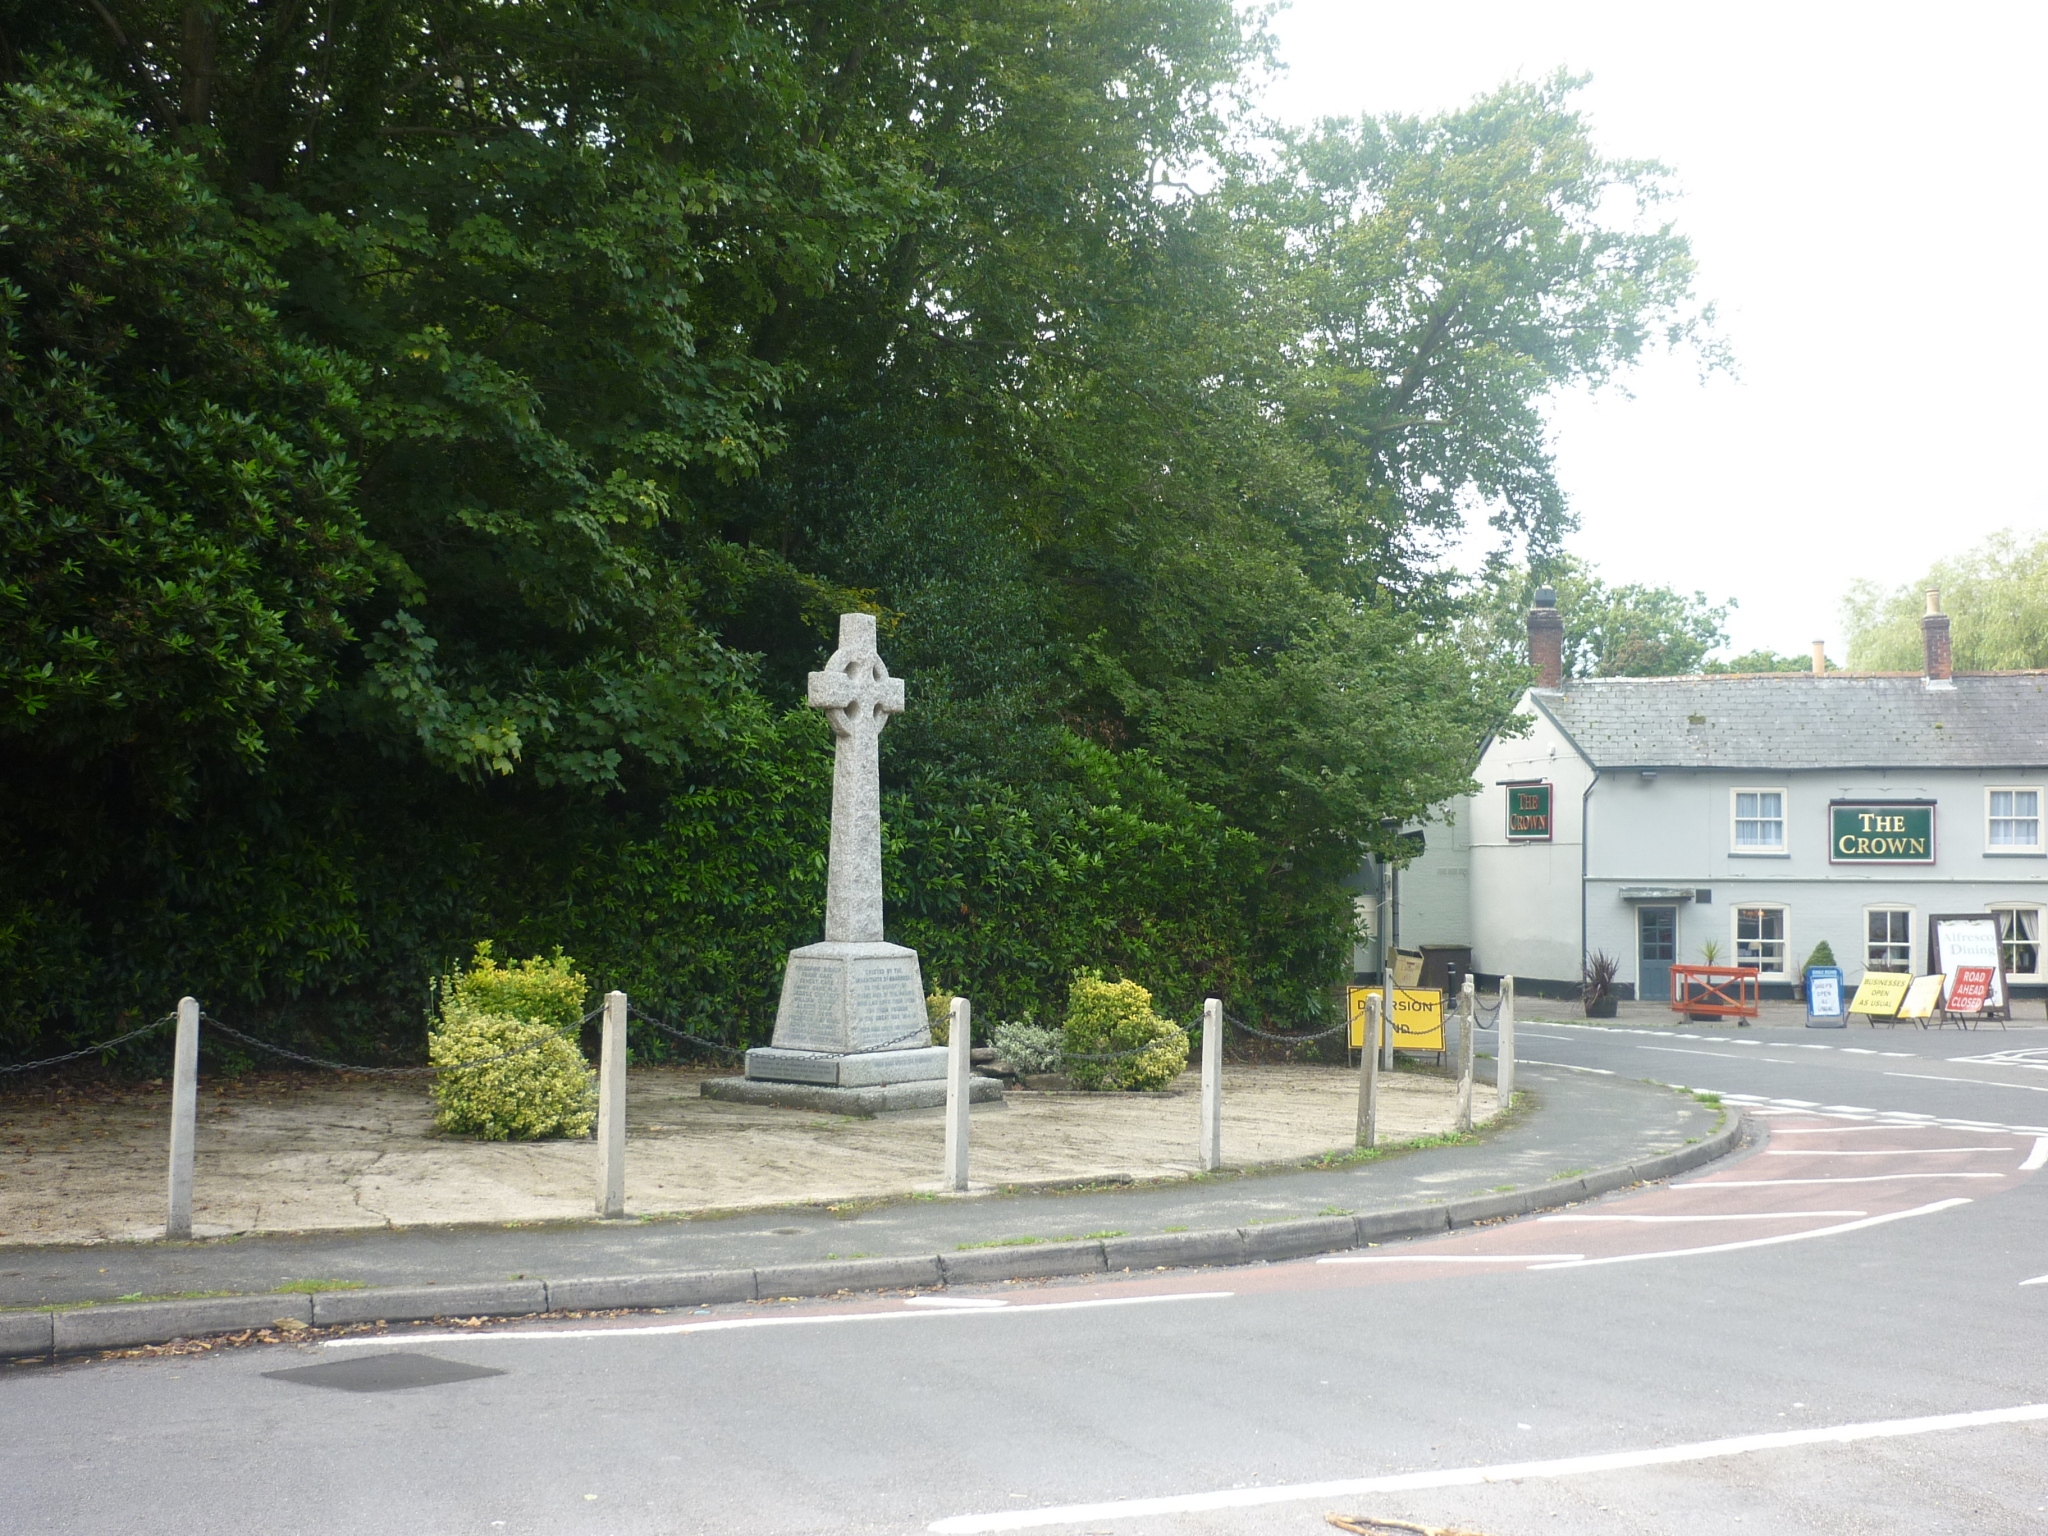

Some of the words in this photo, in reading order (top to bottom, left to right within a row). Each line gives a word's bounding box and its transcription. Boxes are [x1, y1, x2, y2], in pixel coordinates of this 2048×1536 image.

[1518, 793, 1538, 810] THE
[1510, 814, 1547, 831] CROWN
[1858, 813, 1906, 832] THE
[1838, 834, 1925, 854] CROWN
[1942, 932, 1995, 942] Alfresco
[1950, 943, 1996, 957] Dining
[1863, 978, 1906, 987] BUSINESSES
[1963, 971, 1986, 983] ROAD
[1871, 989, 1890, 997] OPEN
[1957, 983, 1985, 996] AHEAD
[1357, 999, 1433, 1012] DRSION
[1870, 1000, 1893, 1008] USUAL
[1951, 996, 1983, 1008] CLOSED
